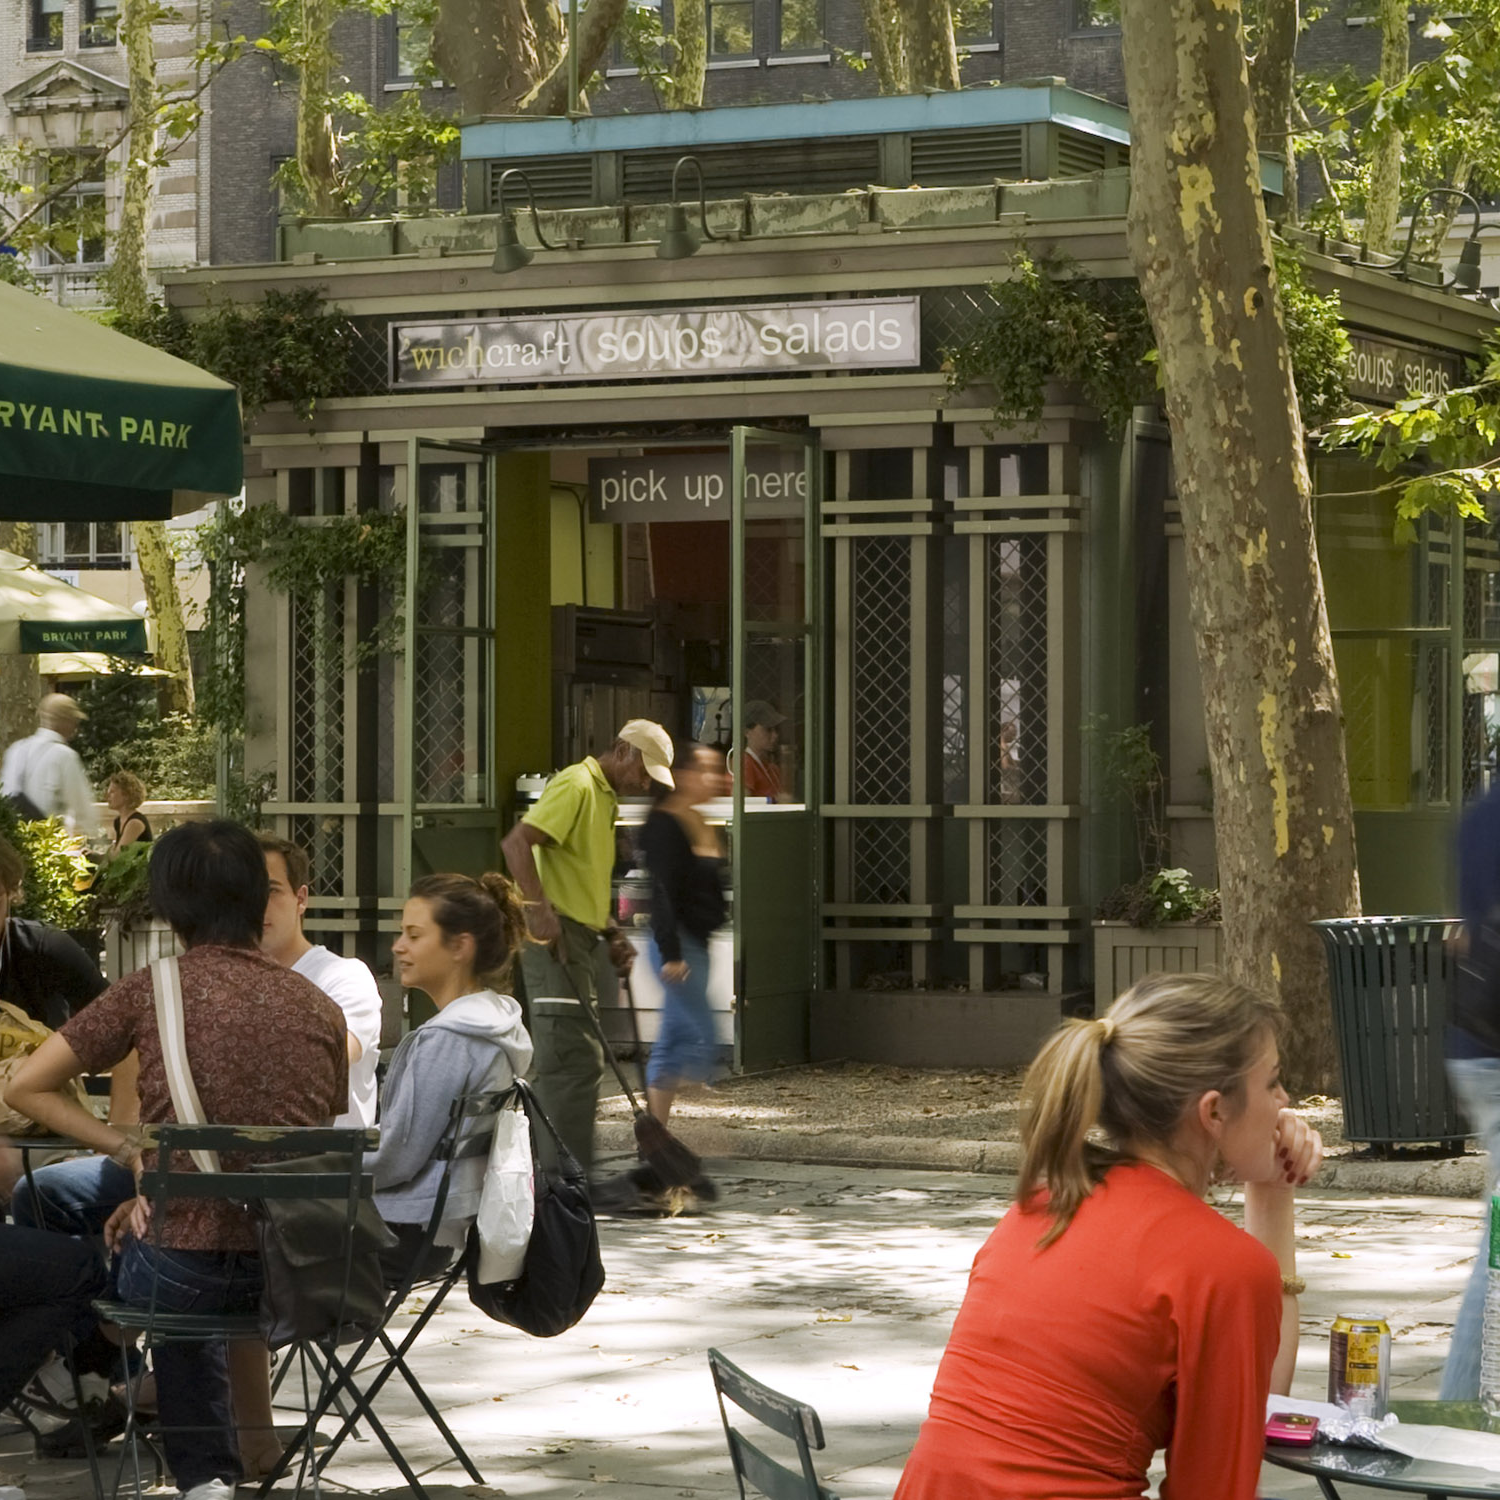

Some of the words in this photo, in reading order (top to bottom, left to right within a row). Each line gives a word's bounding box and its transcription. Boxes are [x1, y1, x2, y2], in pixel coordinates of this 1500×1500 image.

[597, 326, 724, 369] soups
[759, 309, 902, 355] salads
[1347, 351, 1394, 394] soups
[1404, 358, 1449, 397] salads
[120, 416, 192, 449] PARK
[601, 469, 668, 510] pick
[684, 474, 724, 507] up
[743, 466, 806, 498] here
[42, 632, 90, 642] BRYANT
[96, 630, 128, 640] PARK
